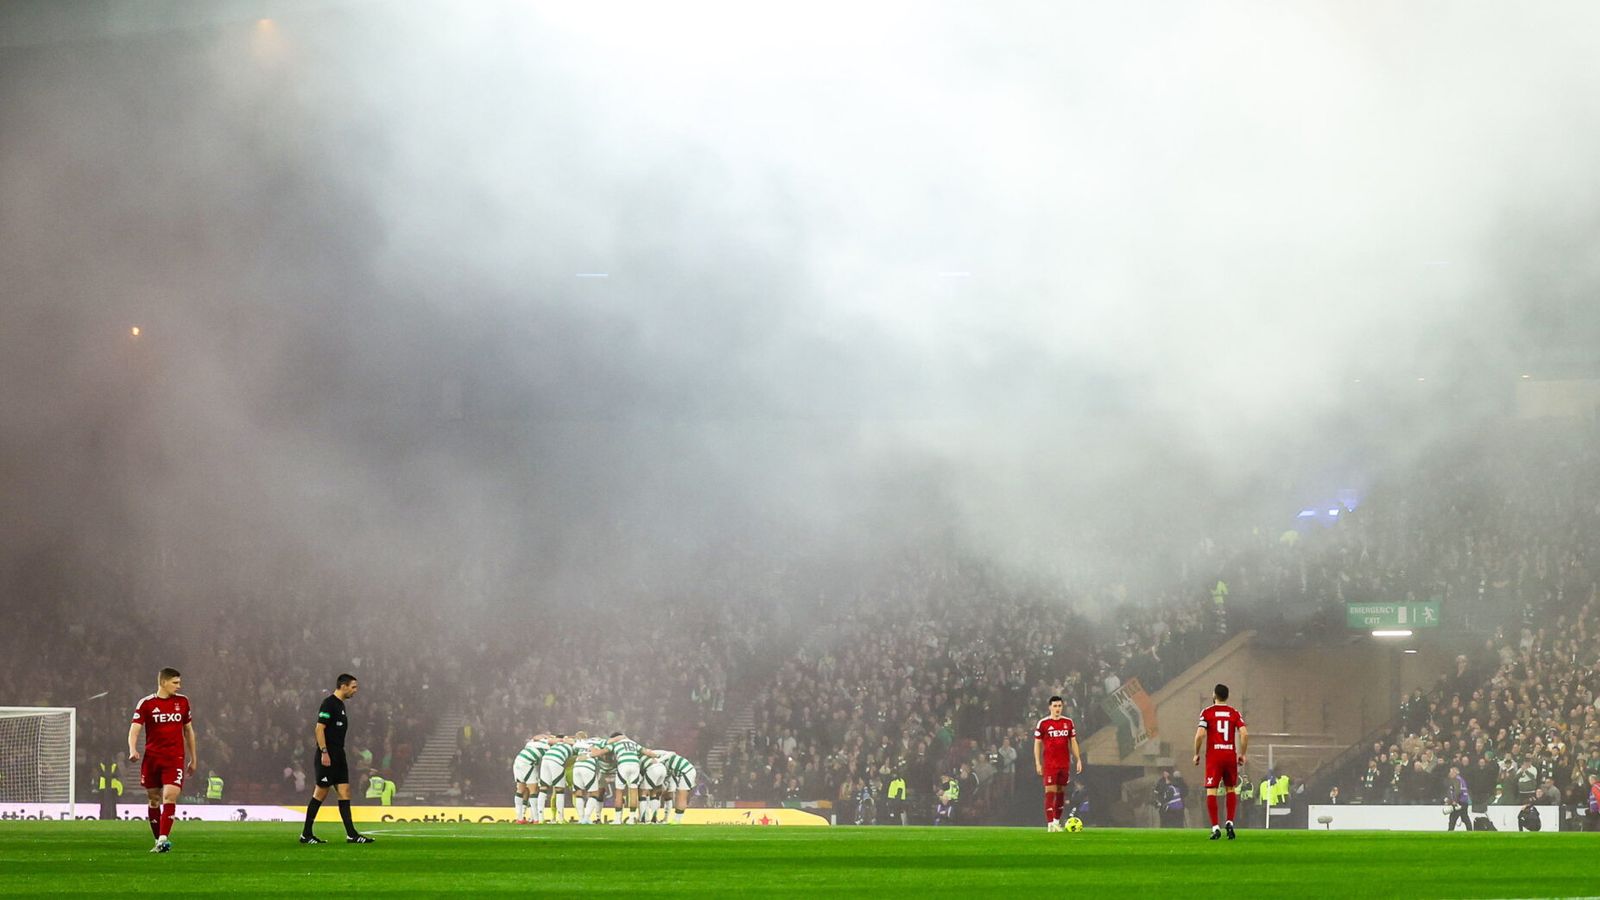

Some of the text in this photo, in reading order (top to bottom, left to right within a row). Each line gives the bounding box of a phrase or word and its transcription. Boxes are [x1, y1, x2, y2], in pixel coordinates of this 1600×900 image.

[1349, 606, 1394, 614] EMERGENCY
[1364, 617, 1381, 625] EXIT
[152, 713, 182, 723] TEXO
[1048, 730, 1069, 738] TEXO
[1216, 720, 1229, 741] 4
[176, 768, 183, 780] 3
